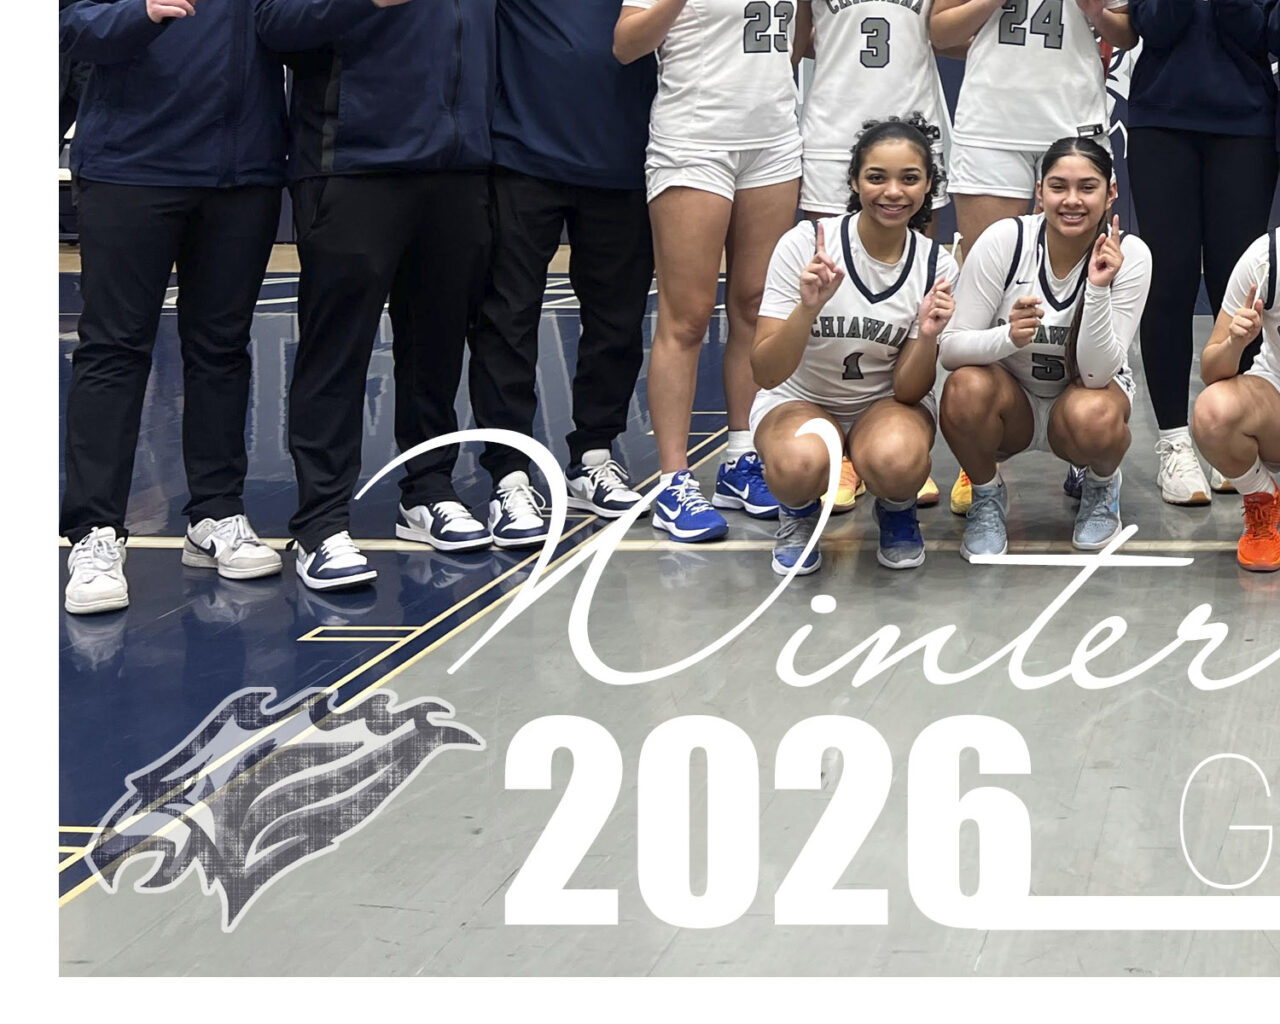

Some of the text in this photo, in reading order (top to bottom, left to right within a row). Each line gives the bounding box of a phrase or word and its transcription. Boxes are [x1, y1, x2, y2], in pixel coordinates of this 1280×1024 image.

[743, 0, 795, 54] 23
[859, 17, 891, 68] 3
[842, 352, 865, 380] 1
[1031, 352, 1066, 382] 5
